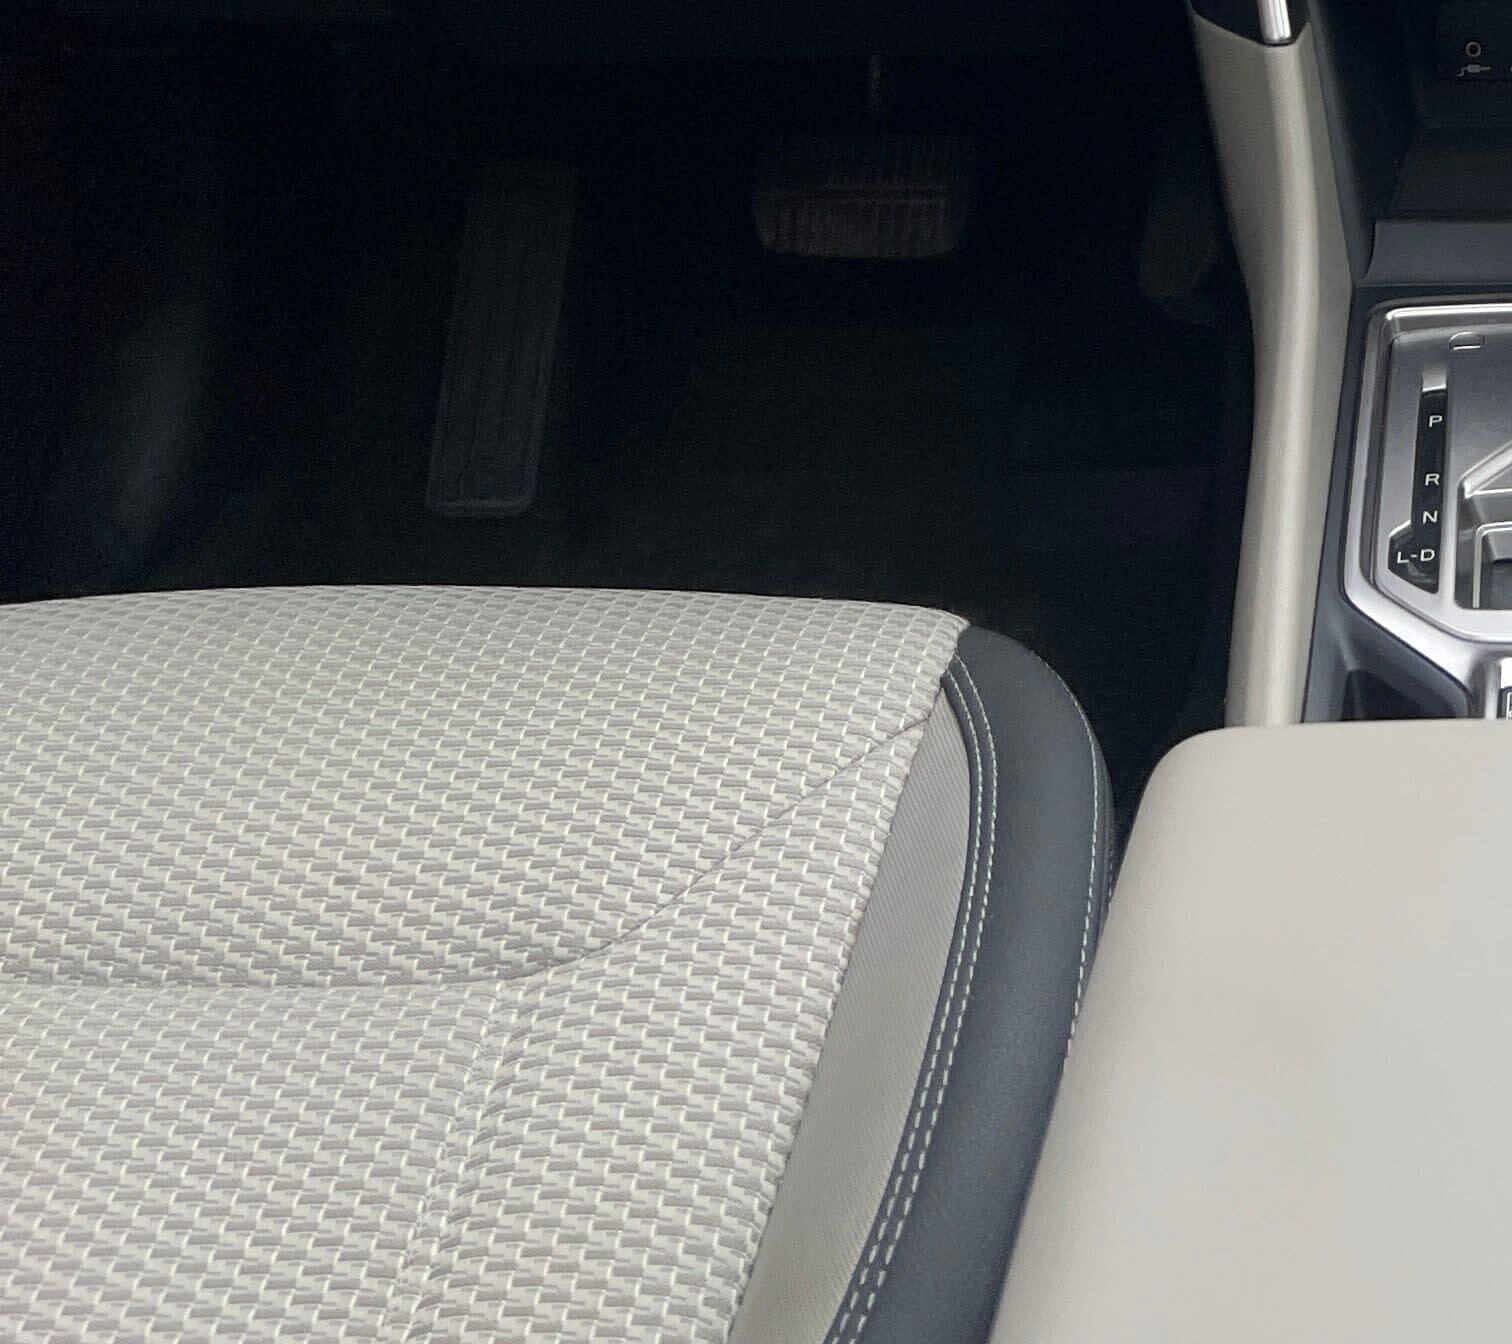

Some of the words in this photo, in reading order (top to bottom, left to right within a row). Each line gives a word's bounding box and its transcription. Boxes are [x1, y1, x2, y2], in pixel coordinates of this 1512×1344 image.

[1429, 415, 1443, 427] P
[1425, 473, 1440, 486] R
[1422, 510, 1438, 523] N
